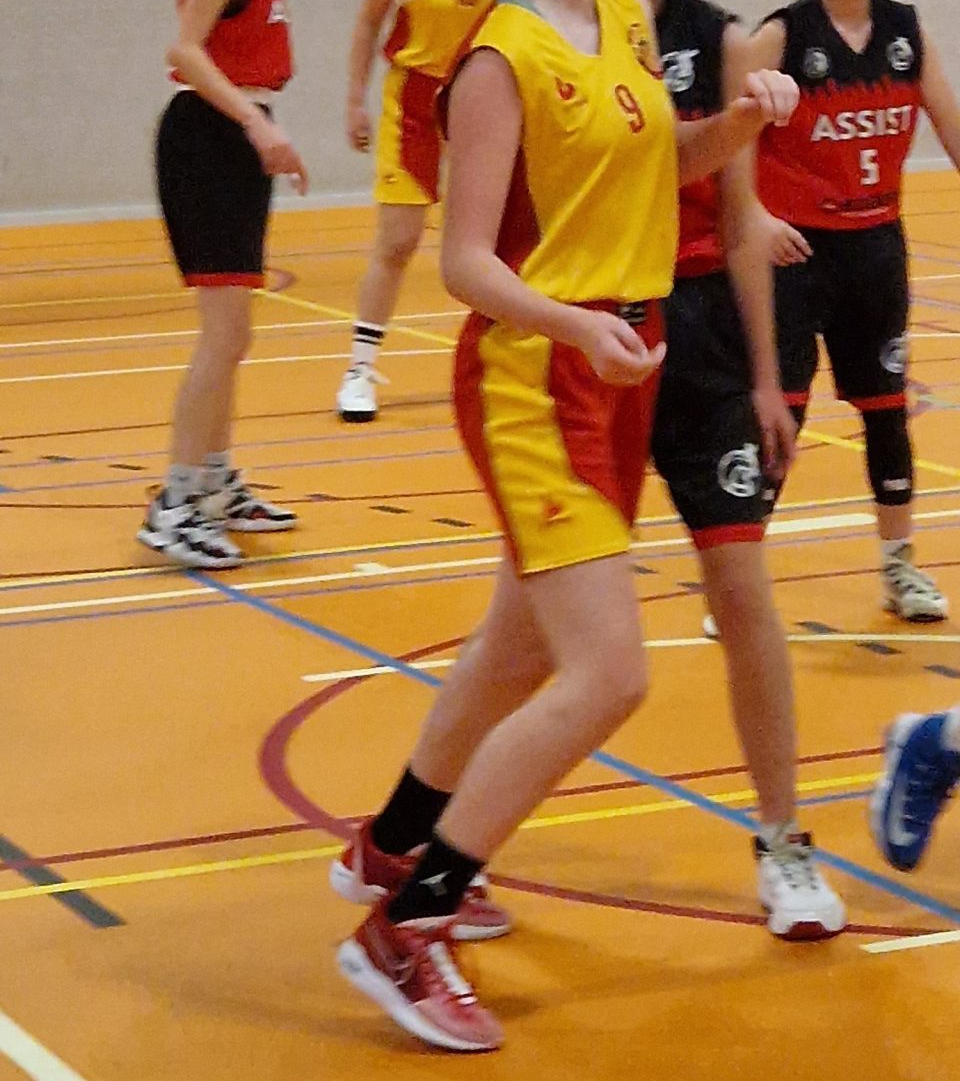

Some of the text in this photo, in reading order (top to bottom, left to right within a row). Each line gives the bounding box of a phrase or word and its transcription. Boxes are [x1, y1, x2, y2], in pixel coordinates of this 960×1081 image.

[615, 84, 645, 133] 9
[811, 105, 914, 142] ASSIST
[859, 149, 881, 186] 5
